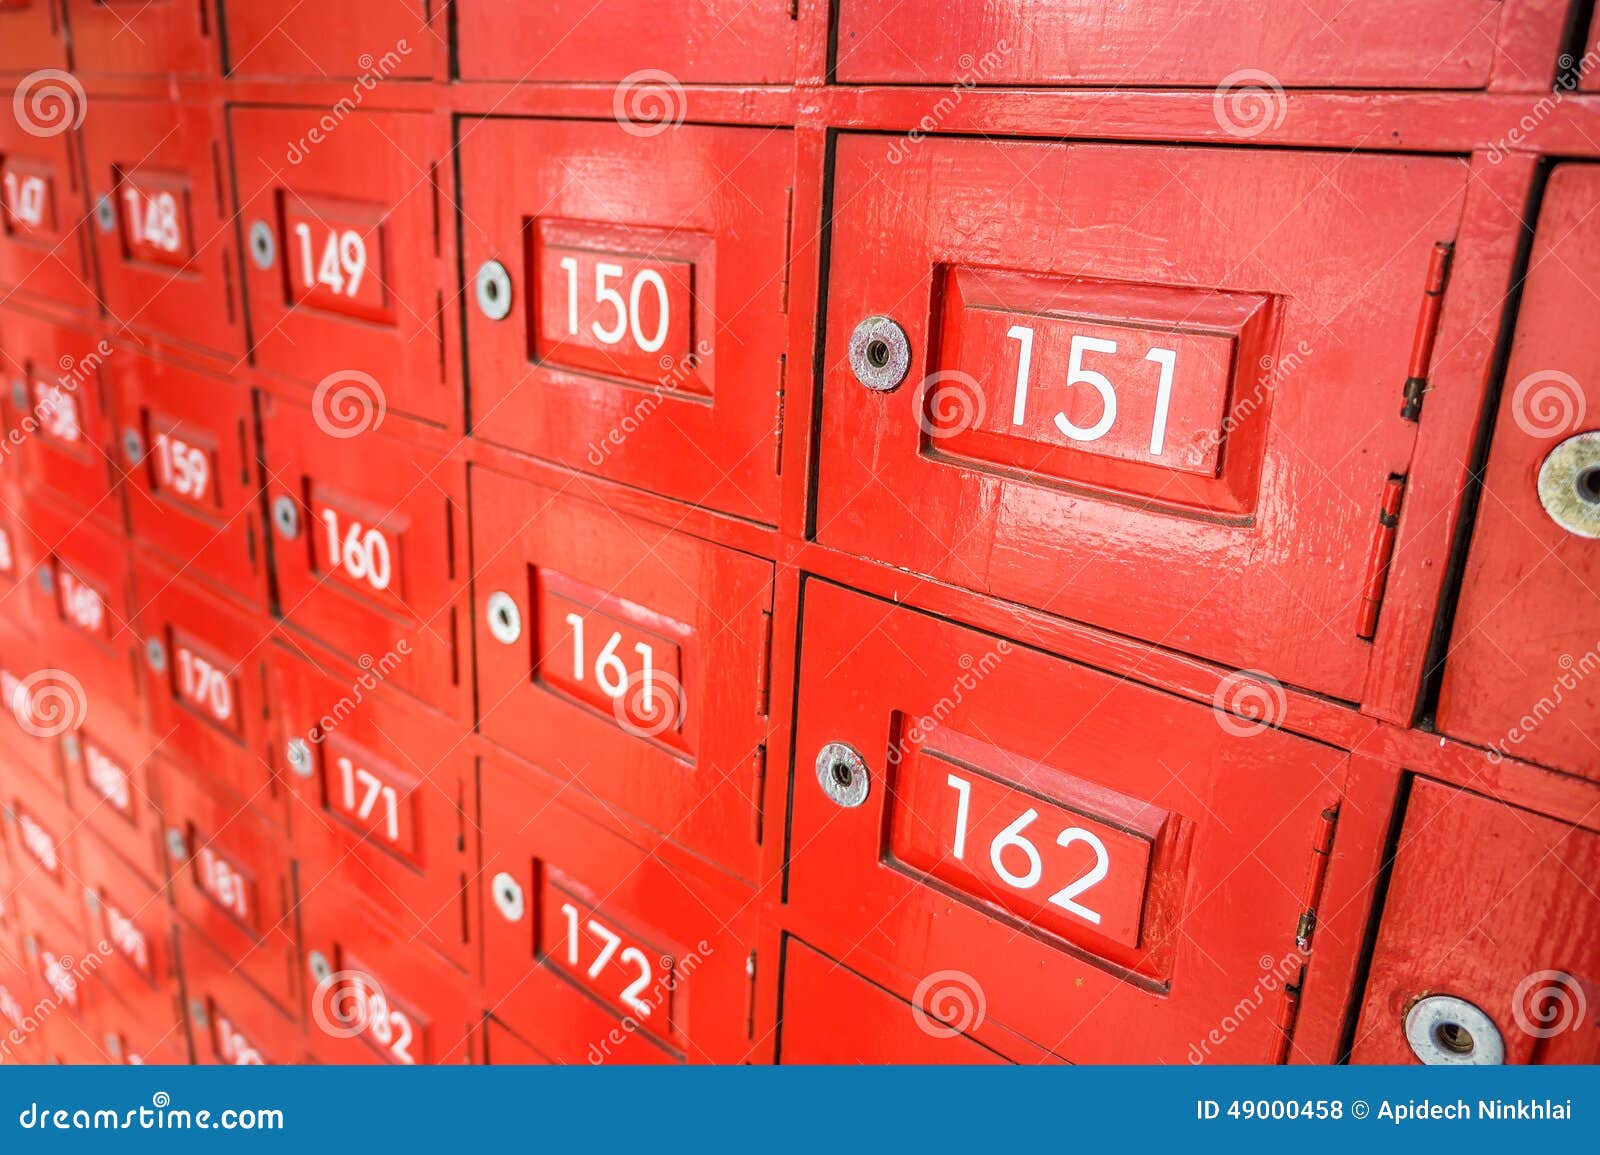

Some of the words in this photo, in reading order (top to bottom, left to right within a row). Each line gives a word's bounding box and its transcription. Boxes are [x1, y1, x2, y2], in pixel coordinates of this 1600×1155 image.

[125, 187, 181, 252] 148
[295, 223, 367, 298] 149
[559, 253, 670, 354] 150
[1006, 326, 1178, 457] 151
[156, 433, 209, 499] 159
[322, 508, 391, 592] 160
[180, 648, 232, 721] 170
[565, 612, 661, 713] 161
[339, 756, 400, 841] 171
[947, 773, 1110, 926] 162
[561, 902, 653, 1017] 172
